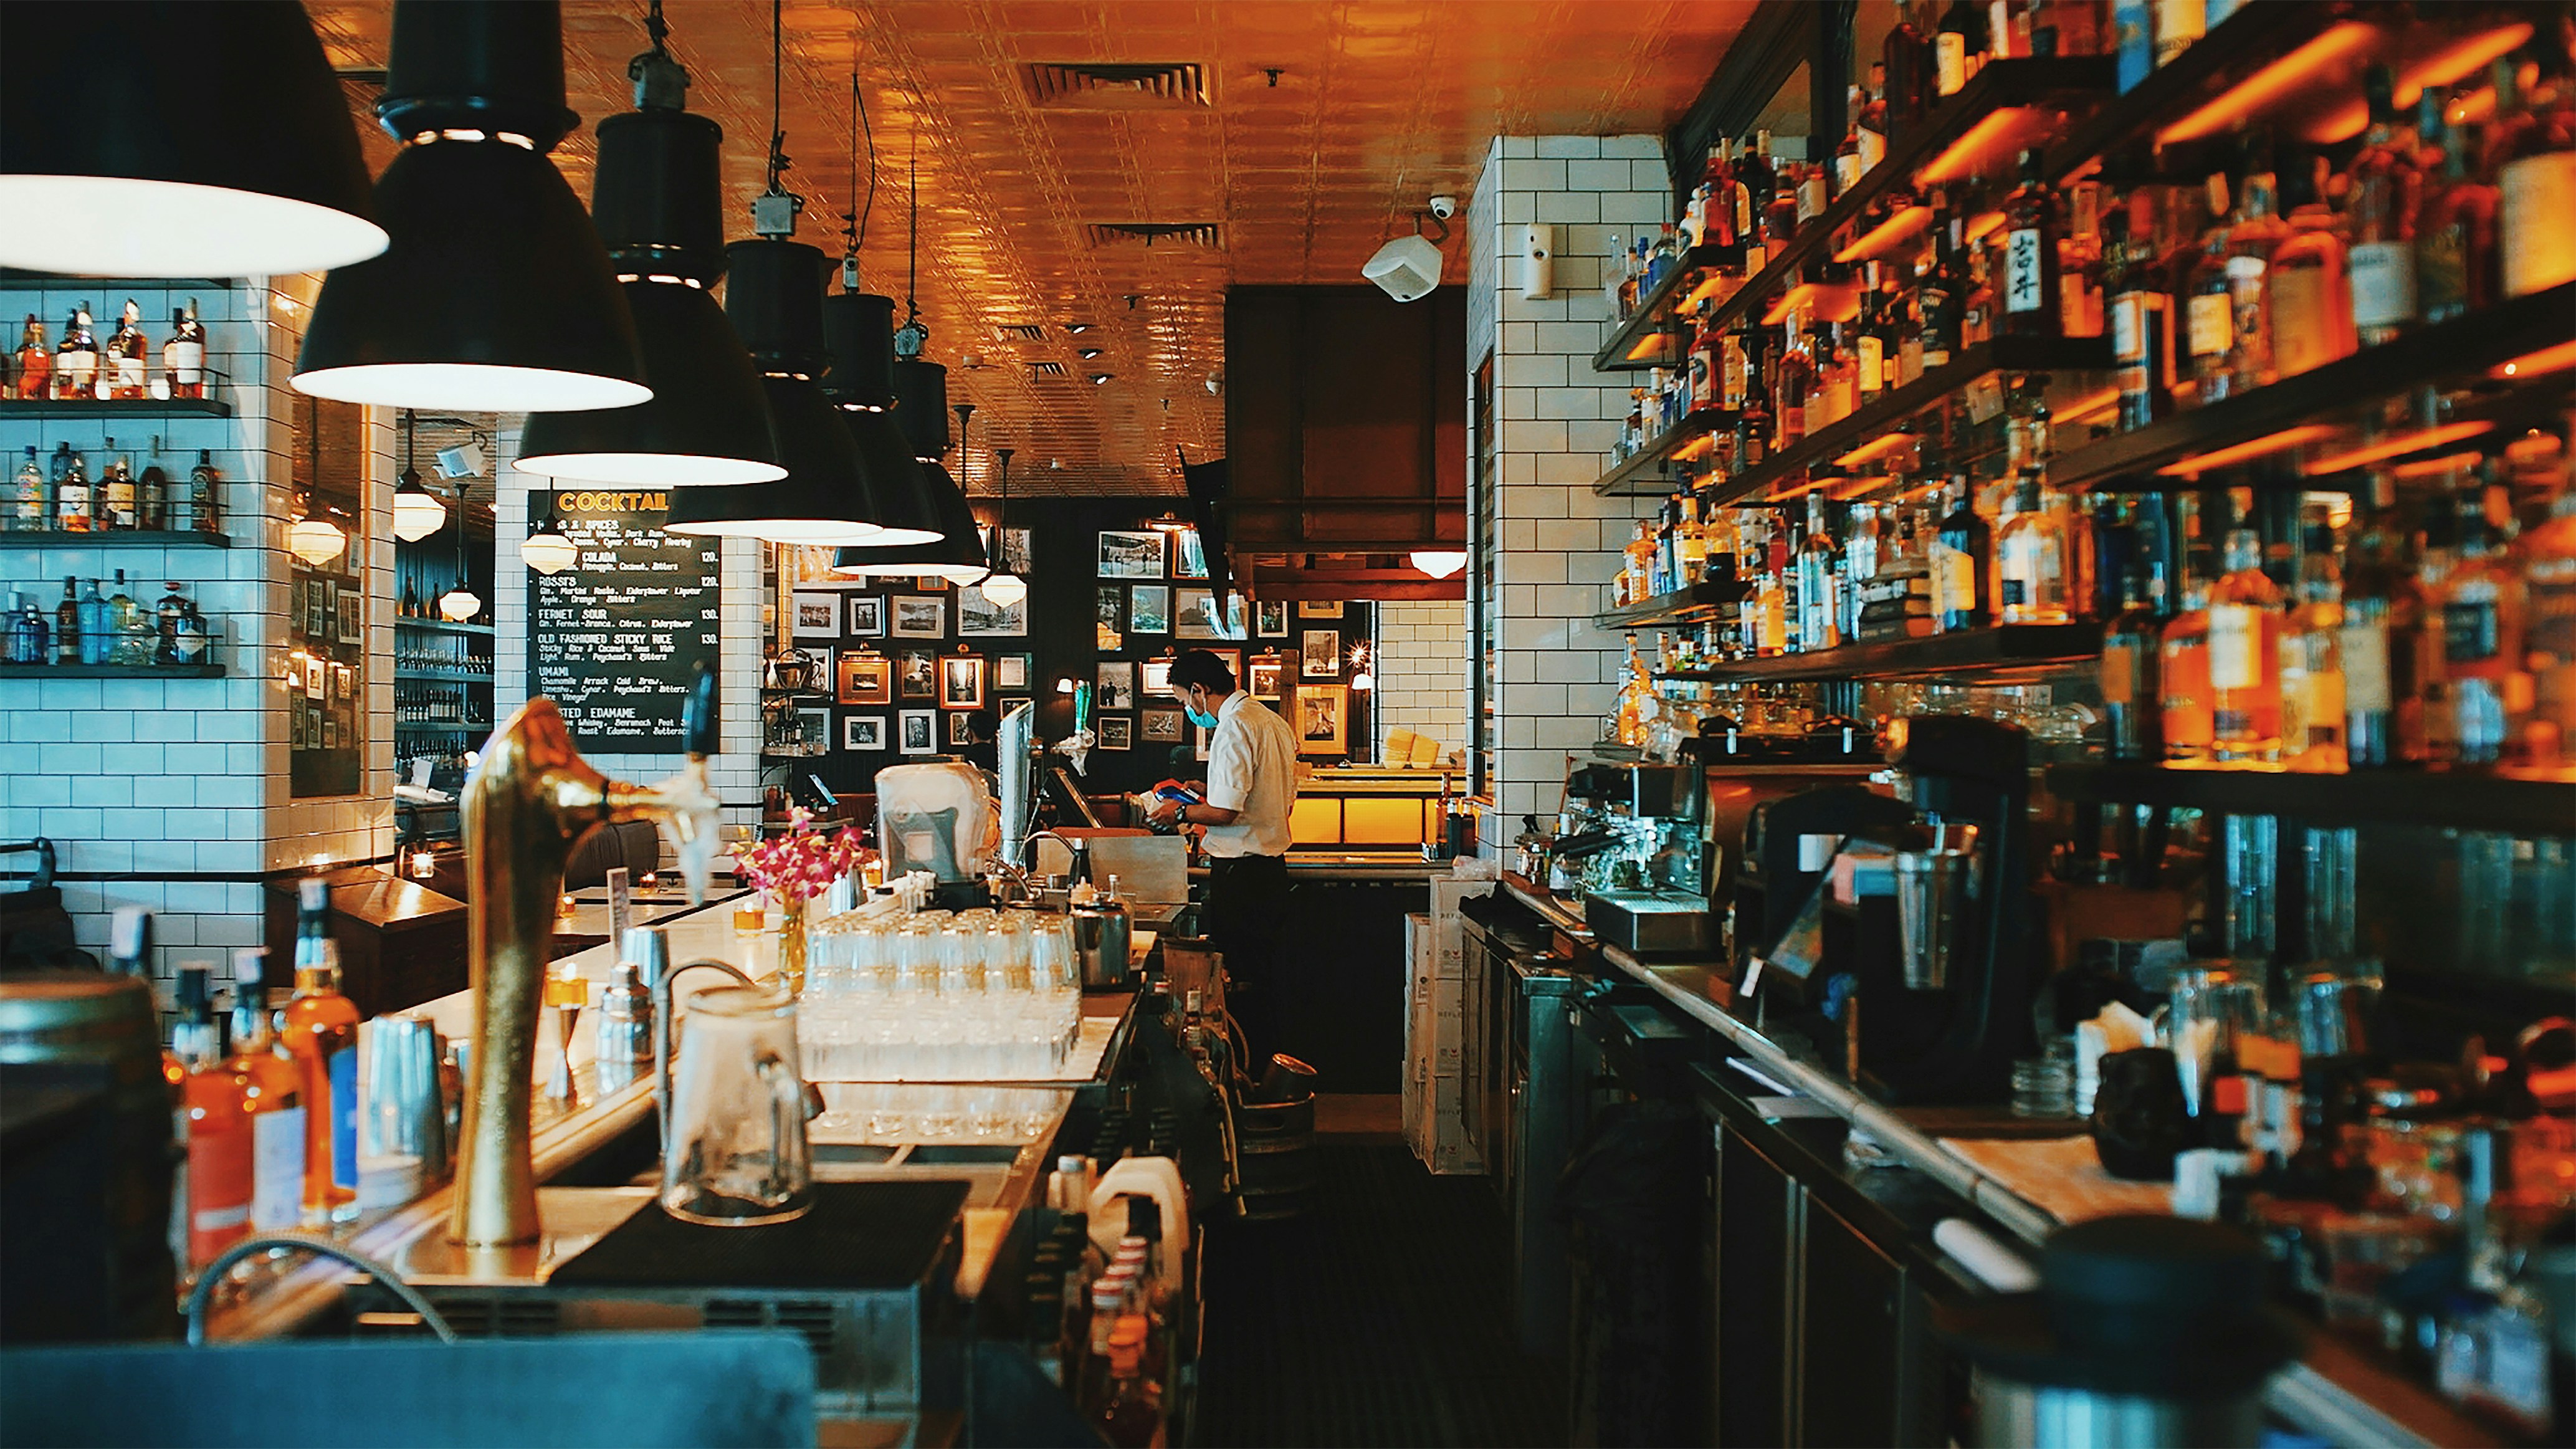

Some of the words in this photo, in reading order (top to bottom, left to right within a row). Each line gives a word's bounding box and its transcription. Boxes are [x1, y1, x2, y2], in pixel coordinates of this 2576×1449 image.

[559, 492, 669, 512] COCKTAIL
[585, 520, 619, 530] SPICES
[582, 552, 617, 562] COLADA
[571, 596, 596, 605] Orange
[606, 596, 636, 604] Bitters
[538, 609, 573, 619] FERNET
[581, 609, 607, 619] SOUR
[538, 634, 555, 644] OLD
[560, 634, 608, 644] FASHIONED
[614, 634, 646, 644] STICKY
[652, 634, 673, 644] RICE
[539, 644, 563, 654] Sticky
[598, 644, 626, 653] Coconut
[540, 653, 559, 662] Light
[639, 653, 667, 662] Bitters
[538, 667, 570, 677] UMAMI
[562, 694, 588, 704] Vinegar
[590, 708, 636, 718] EDAMAME
